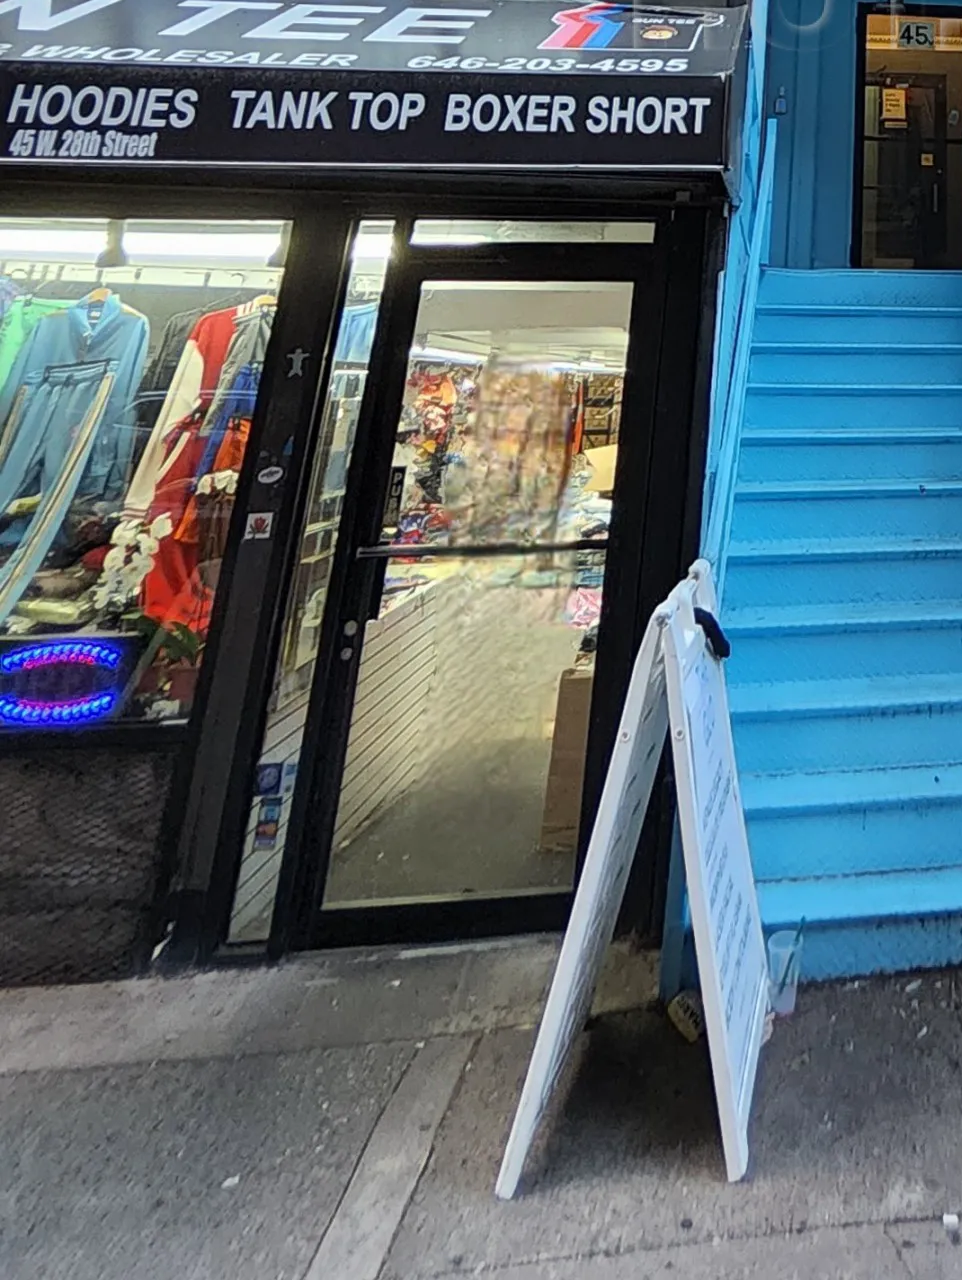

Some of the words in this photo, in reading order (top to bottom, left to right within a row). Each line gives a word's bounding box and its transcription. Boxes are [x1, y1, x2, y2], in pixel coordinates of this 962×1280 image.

[159, 0, 491, 44] TEE
[900, 24, 929, 46] 45
[21, 44, 358, 70] WHOLESALER
[406, 55, 689, 73] 646-203-4595
[6, 83, 199, 128] HOODIES
[230, 90, 339, 130] TANK
[348, 91, 426, 132] TOP
[443, 93, 575, 134] BOXER
[586, 95, 711, 136] SHORT
[8, 129, 36, 157] 45
[35, 130, 58, 157] W.
[58, 129, 101, 157] 28th
[101, 129, 159, 158] Street
